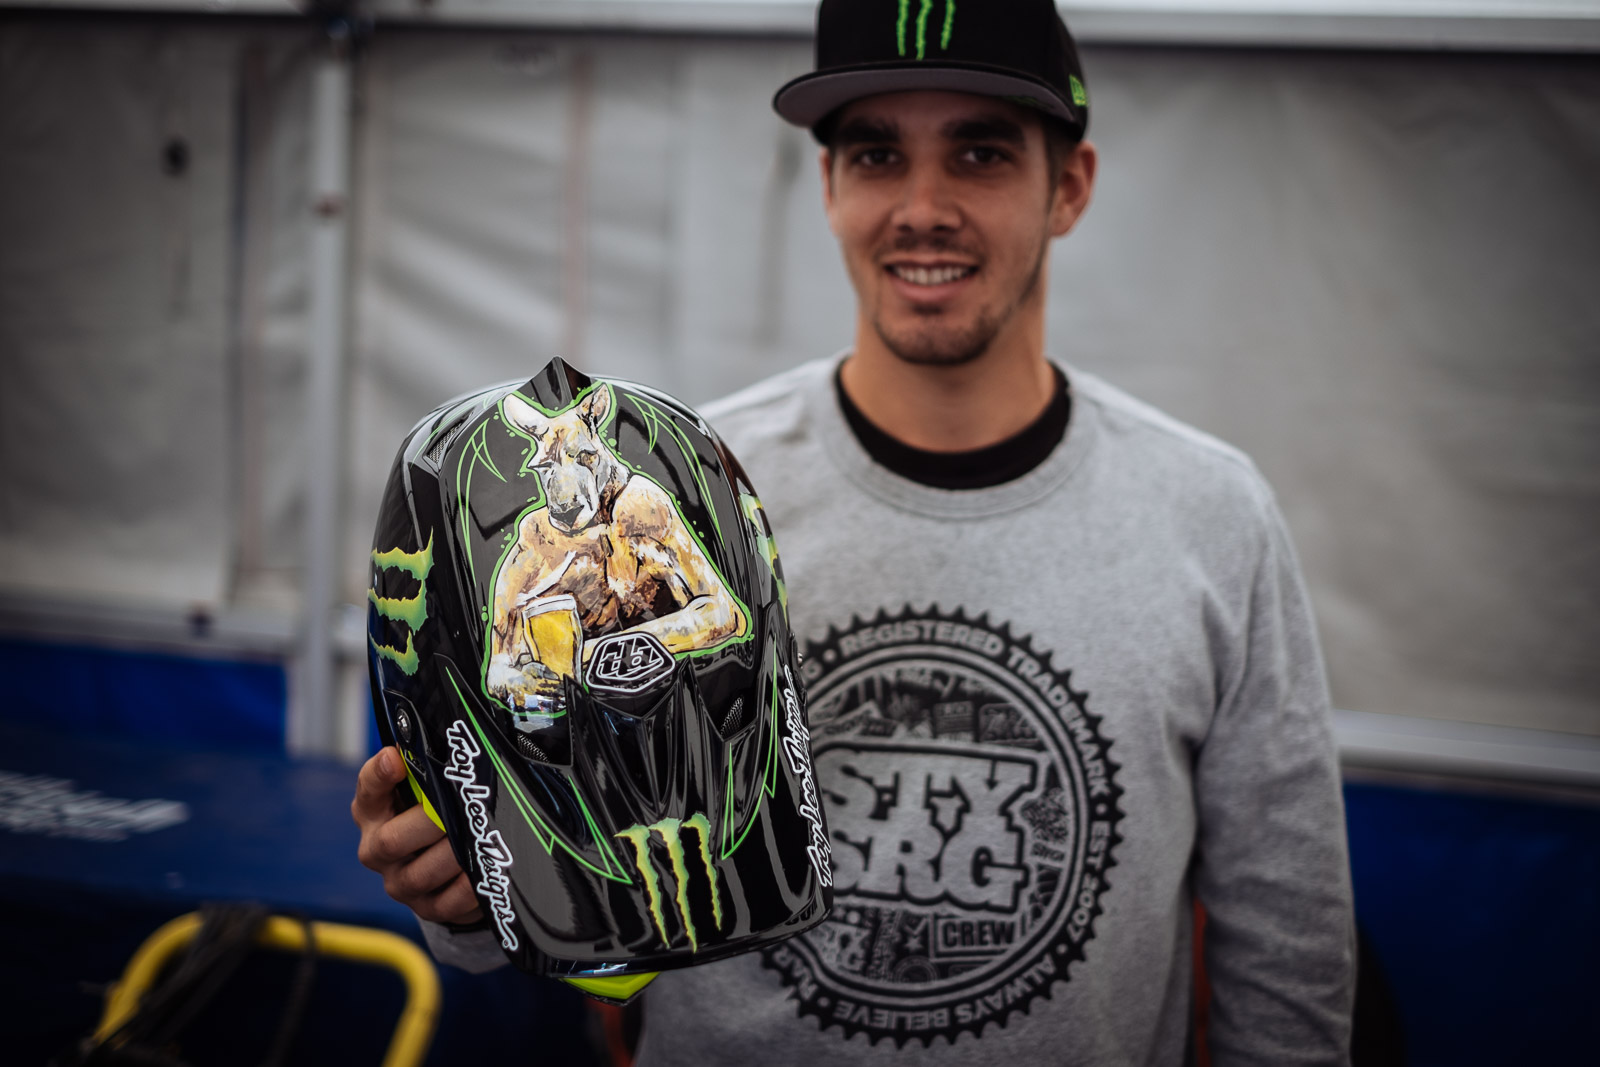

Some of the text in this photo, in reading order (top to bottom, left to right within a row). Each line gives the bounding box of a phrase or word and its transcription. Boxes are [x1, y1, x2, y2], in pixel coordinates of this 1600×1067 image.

[839, 620, 1004, 656] REGISTERED
[1007, 645, 1112, 797] TRADEMARK
[444, 719, 519, 951] Troy Lee Designs
[1066, 820, 1110, 944] EST 2007
[833, 953, 1056, 1030] ALWAYS BELIEVE
[942, 920, 1014, 947] CREW
